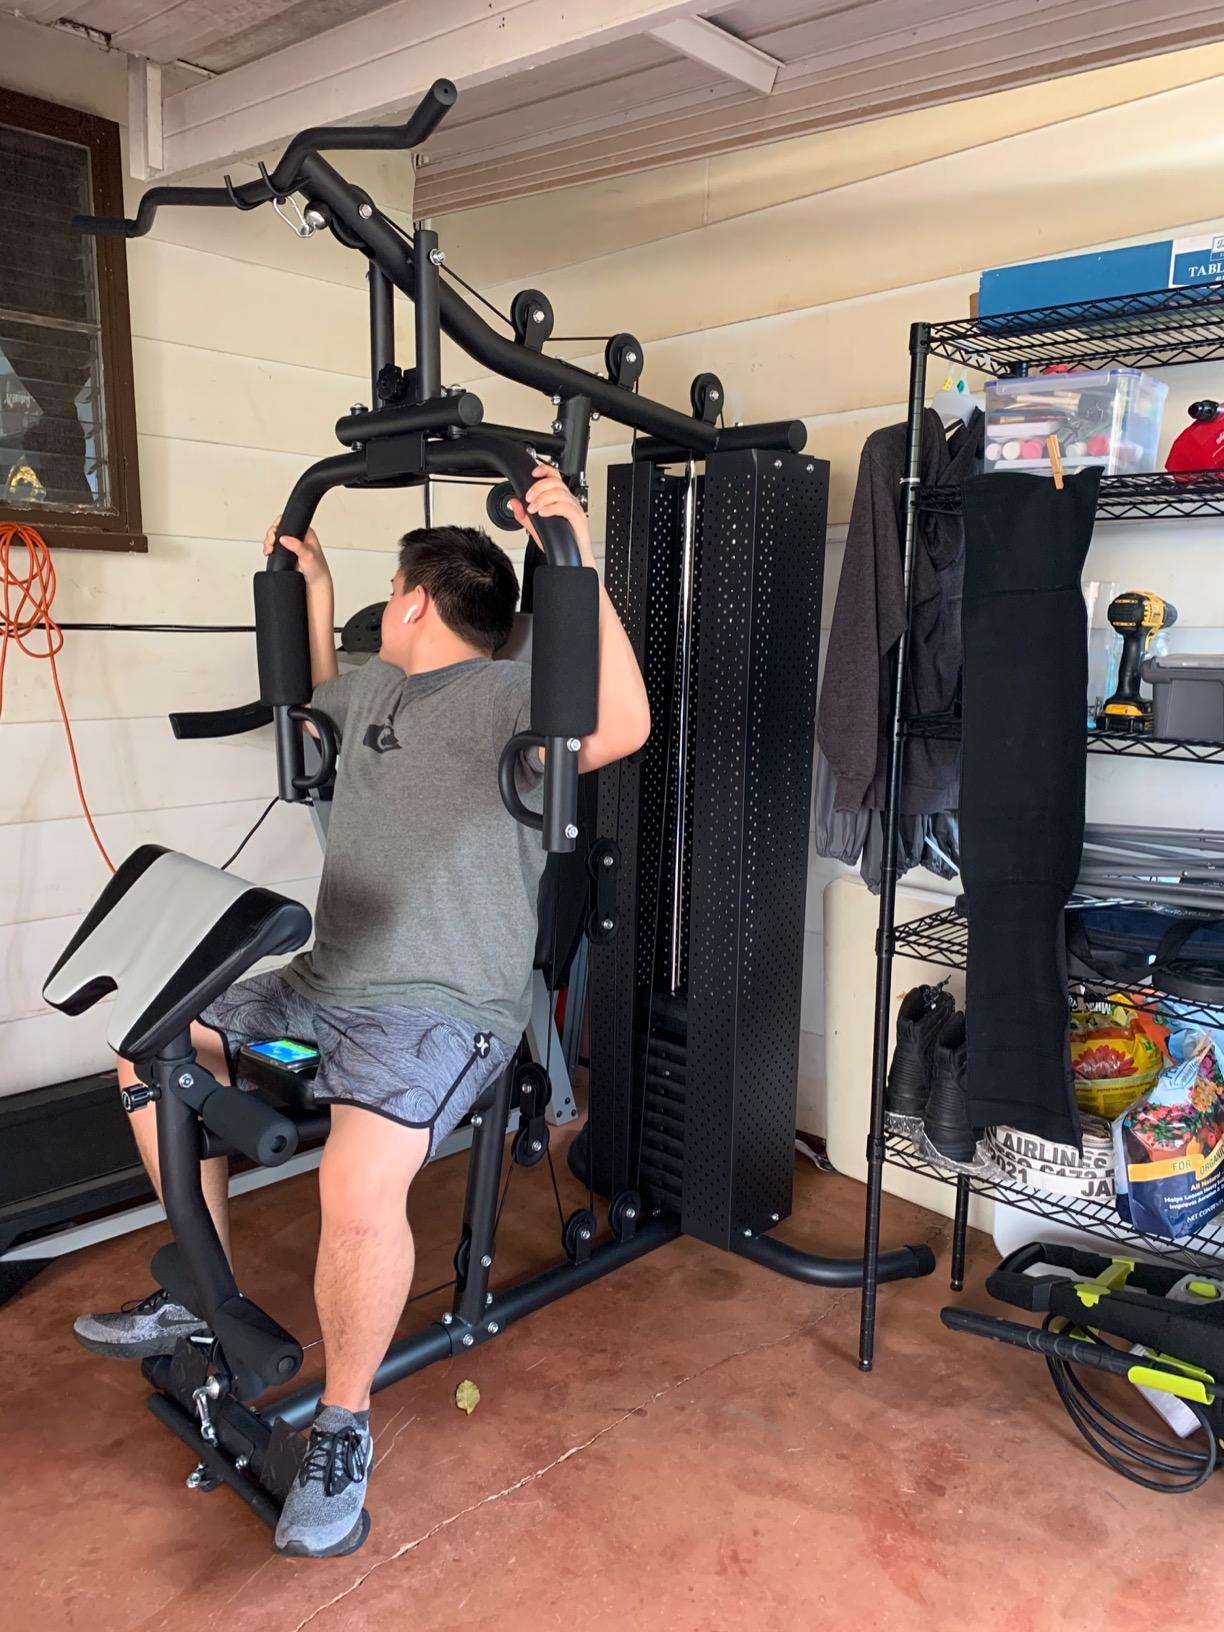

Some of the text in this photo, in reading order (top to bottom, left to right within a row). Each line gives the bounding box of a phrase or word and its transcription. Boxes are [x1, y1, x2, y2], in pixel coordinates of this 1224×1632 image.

[1172, 1159, 1192, 1172] FOR
[1164, 1196, 1184, 1205] Helps
[1187, 1214, 1199, 1224] NET
